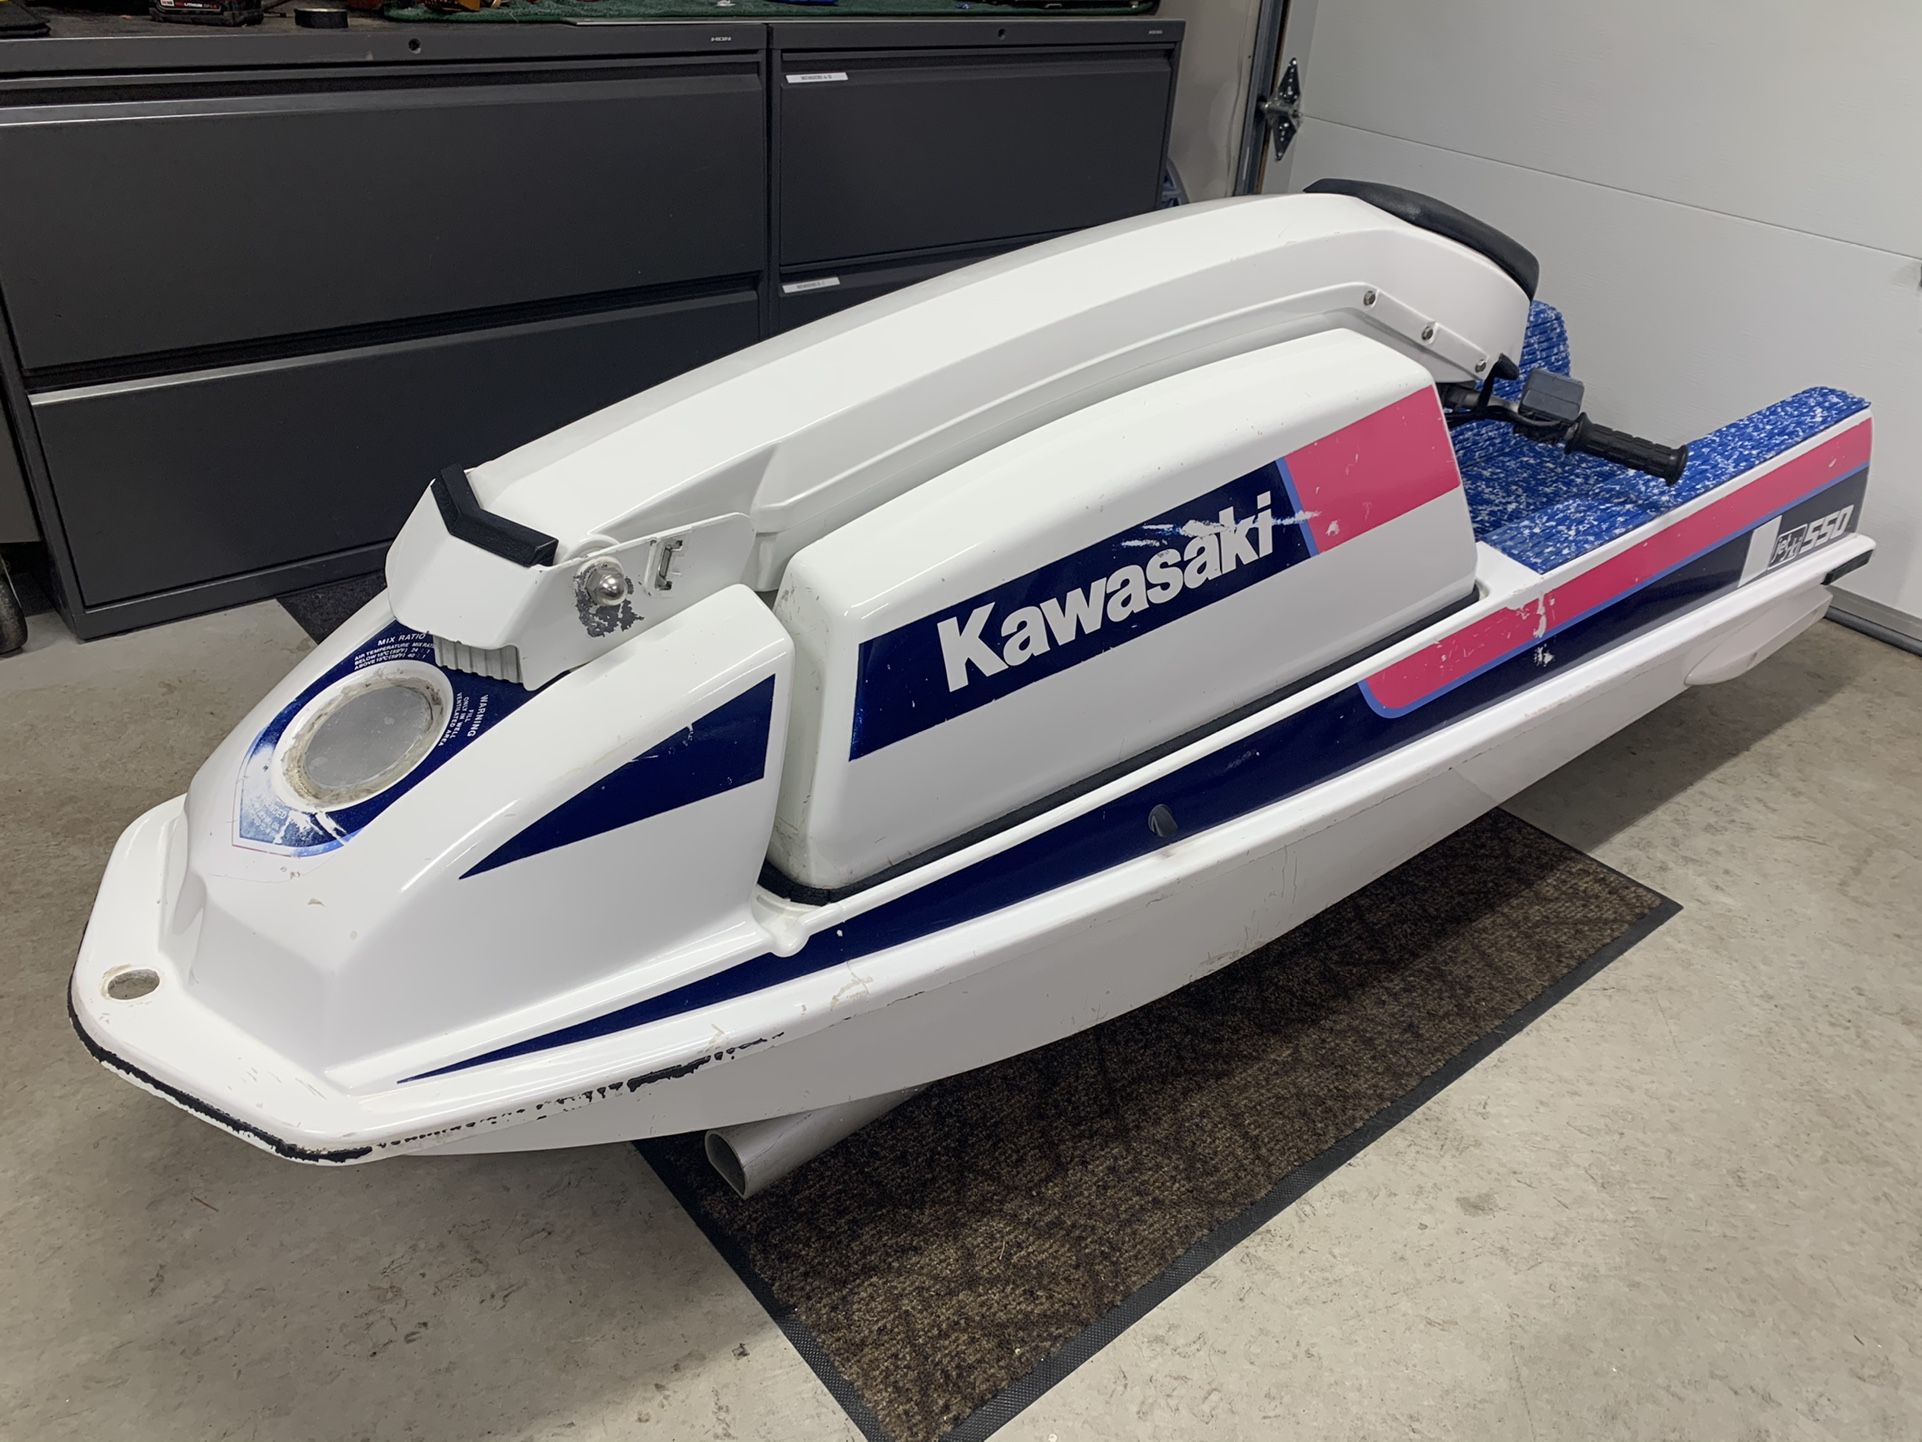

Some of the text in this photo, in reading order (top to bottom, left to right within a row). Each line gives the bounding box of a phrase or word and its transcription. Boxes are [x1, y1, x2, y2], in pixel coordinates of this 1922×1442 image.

[1799, 504, 1855, 554] 550
[937, 490, 1274, 693] Kawasaki
[354, 653, 366, 661] AIR
[366, 642, 410, 656] TEMPERATURE
[377, 633, 426, 646] MIX RATIO
[354, 654, 377, 666] BELOW
[354, 660, 376, 670] ABOVE
[438, 692, 463, 747] VENTILATED AREA
[449, 696, 470, 739] ONLY IN WELL
[464, 709, 475, 723] FILL
[467, 694, 489, 737] WARNING
